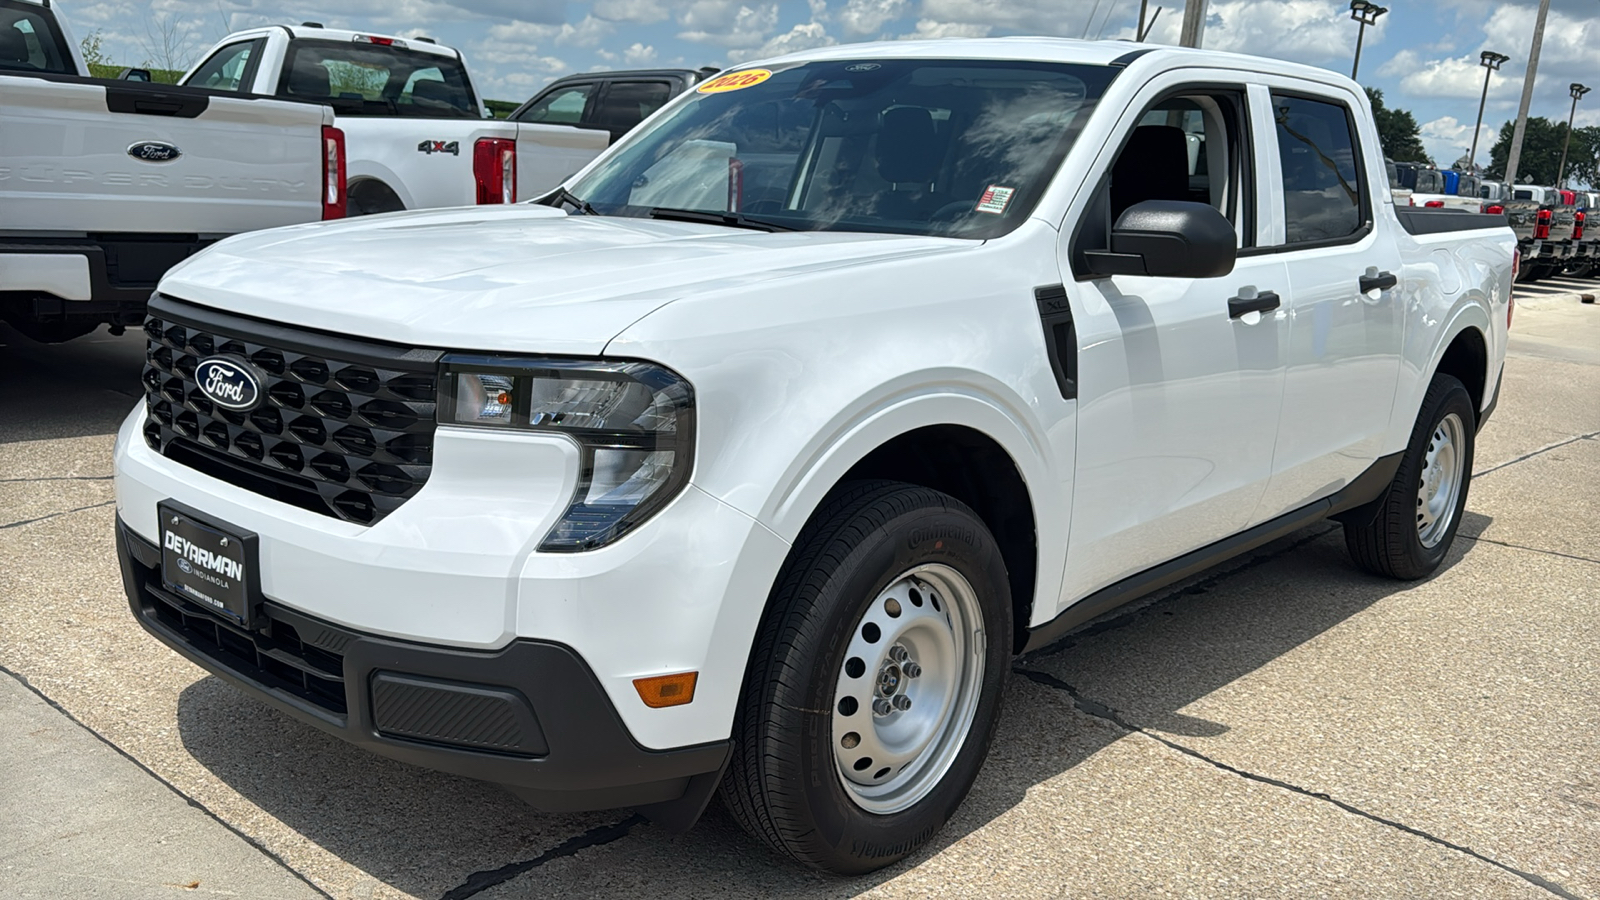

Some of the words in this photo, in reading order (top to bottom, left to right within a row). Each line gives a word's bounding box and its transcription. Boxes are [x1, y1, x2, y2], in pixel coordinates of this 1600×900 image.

[701, 73, 766, 88] 2026
[141, 145, 171, 159] Ford
[184, 175, 305, 193] DUTY
[1047, 300, 1068, 311] XL
[206, 365, 244, 402] Ford
[908, 523, 976, 550] Continental
[164, 530, 242, 582] DEYARMAN
[193, 568, 229, 589] INDIANOLA
[184, 584, 224, 608] DEYARMANFORD.COM
